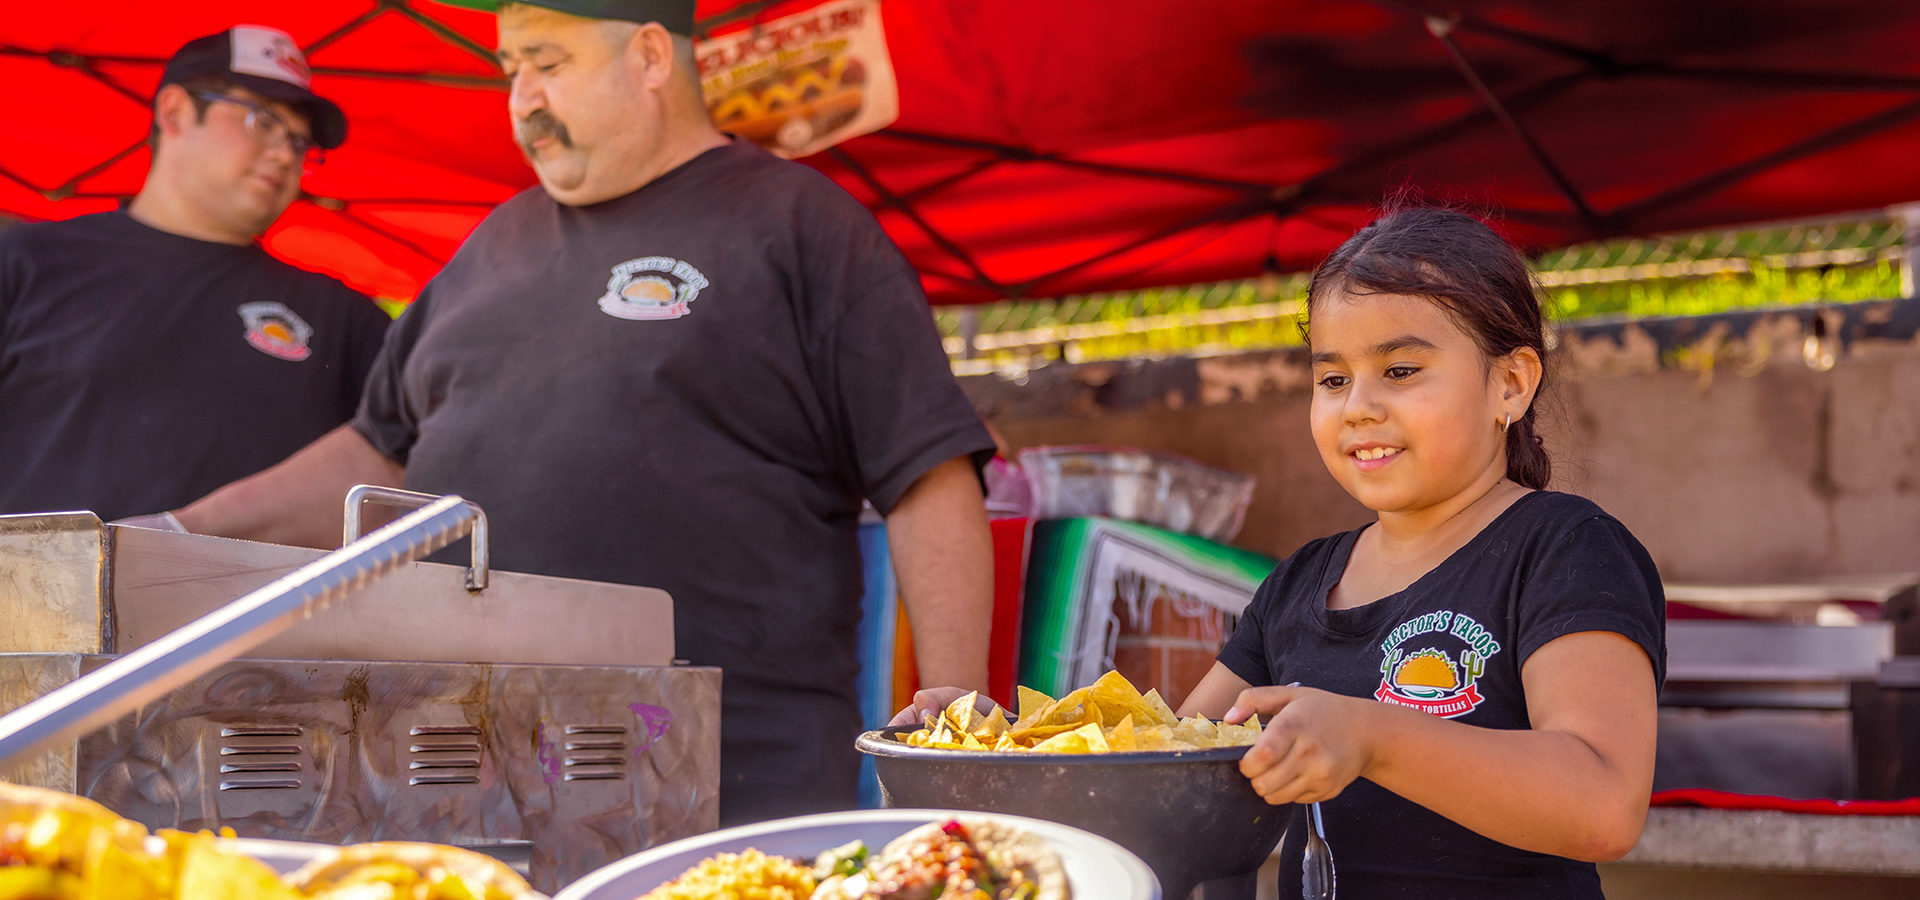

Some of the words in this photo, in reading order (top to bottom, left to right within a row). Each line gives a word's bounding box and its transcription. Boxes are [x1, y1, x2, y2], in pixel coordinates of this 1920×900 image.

[695, 7, 864, 76] ELICIOUS!
[1382, 611, 1452, 654] HECTOR'S
[1451, 614, 1500, 658] TACOS
[1422, 700, 1467, 714] TORTILLAS
